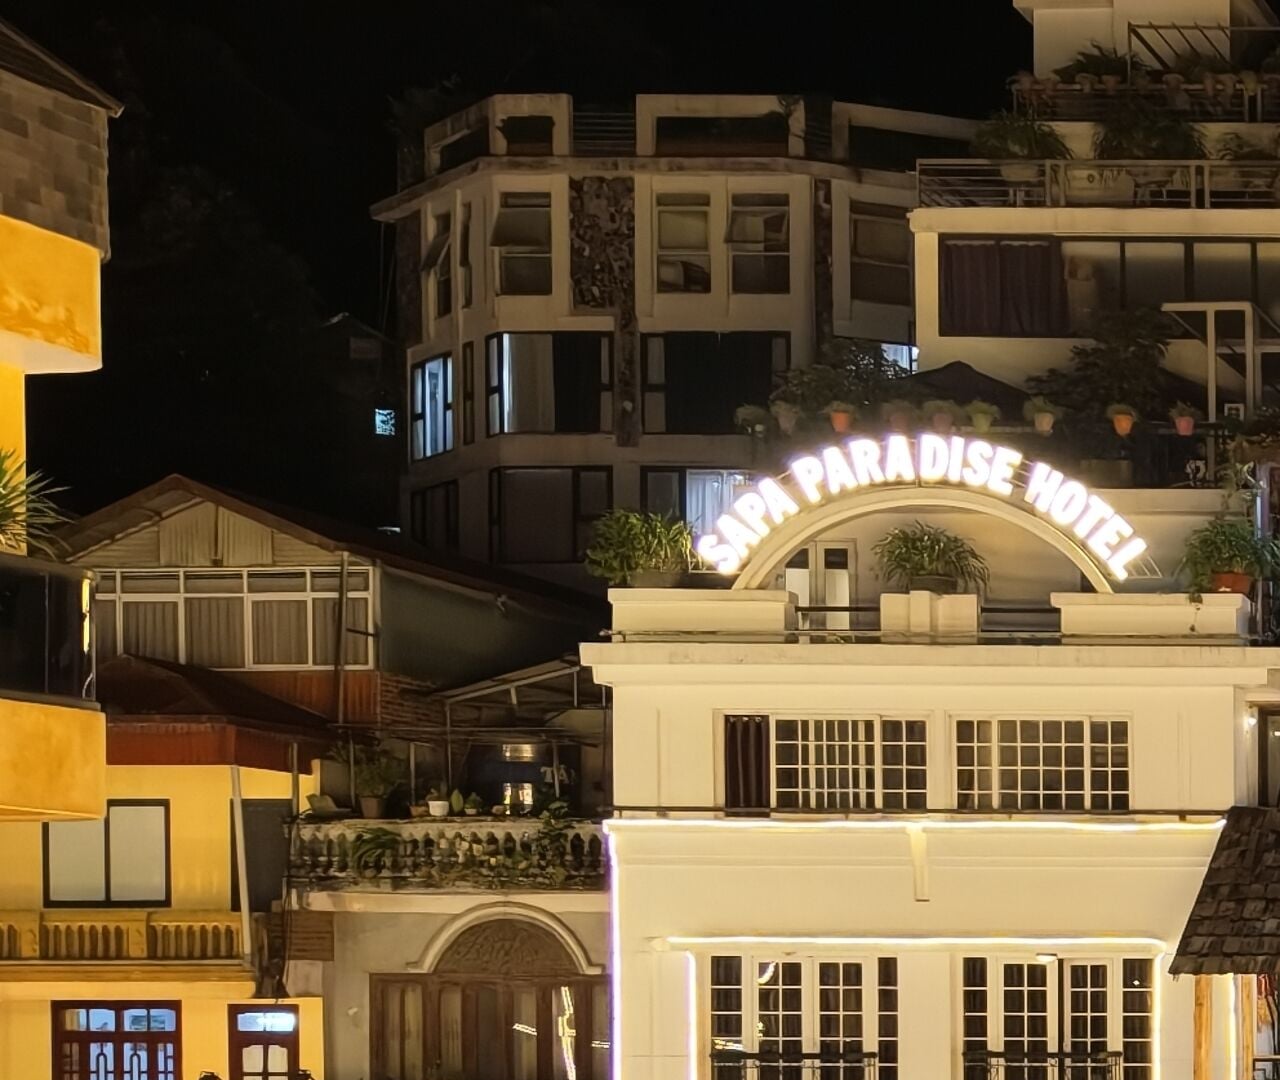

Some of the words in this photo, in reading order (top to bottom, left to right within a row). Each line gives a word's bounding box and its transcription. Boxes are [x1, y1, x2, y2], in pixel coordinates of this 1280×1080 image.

[697, 476, 799, 575] SAPA
[792, 432, 1022, 504] PARADISE
[1023, 462, 1147, 581] HOTEL
